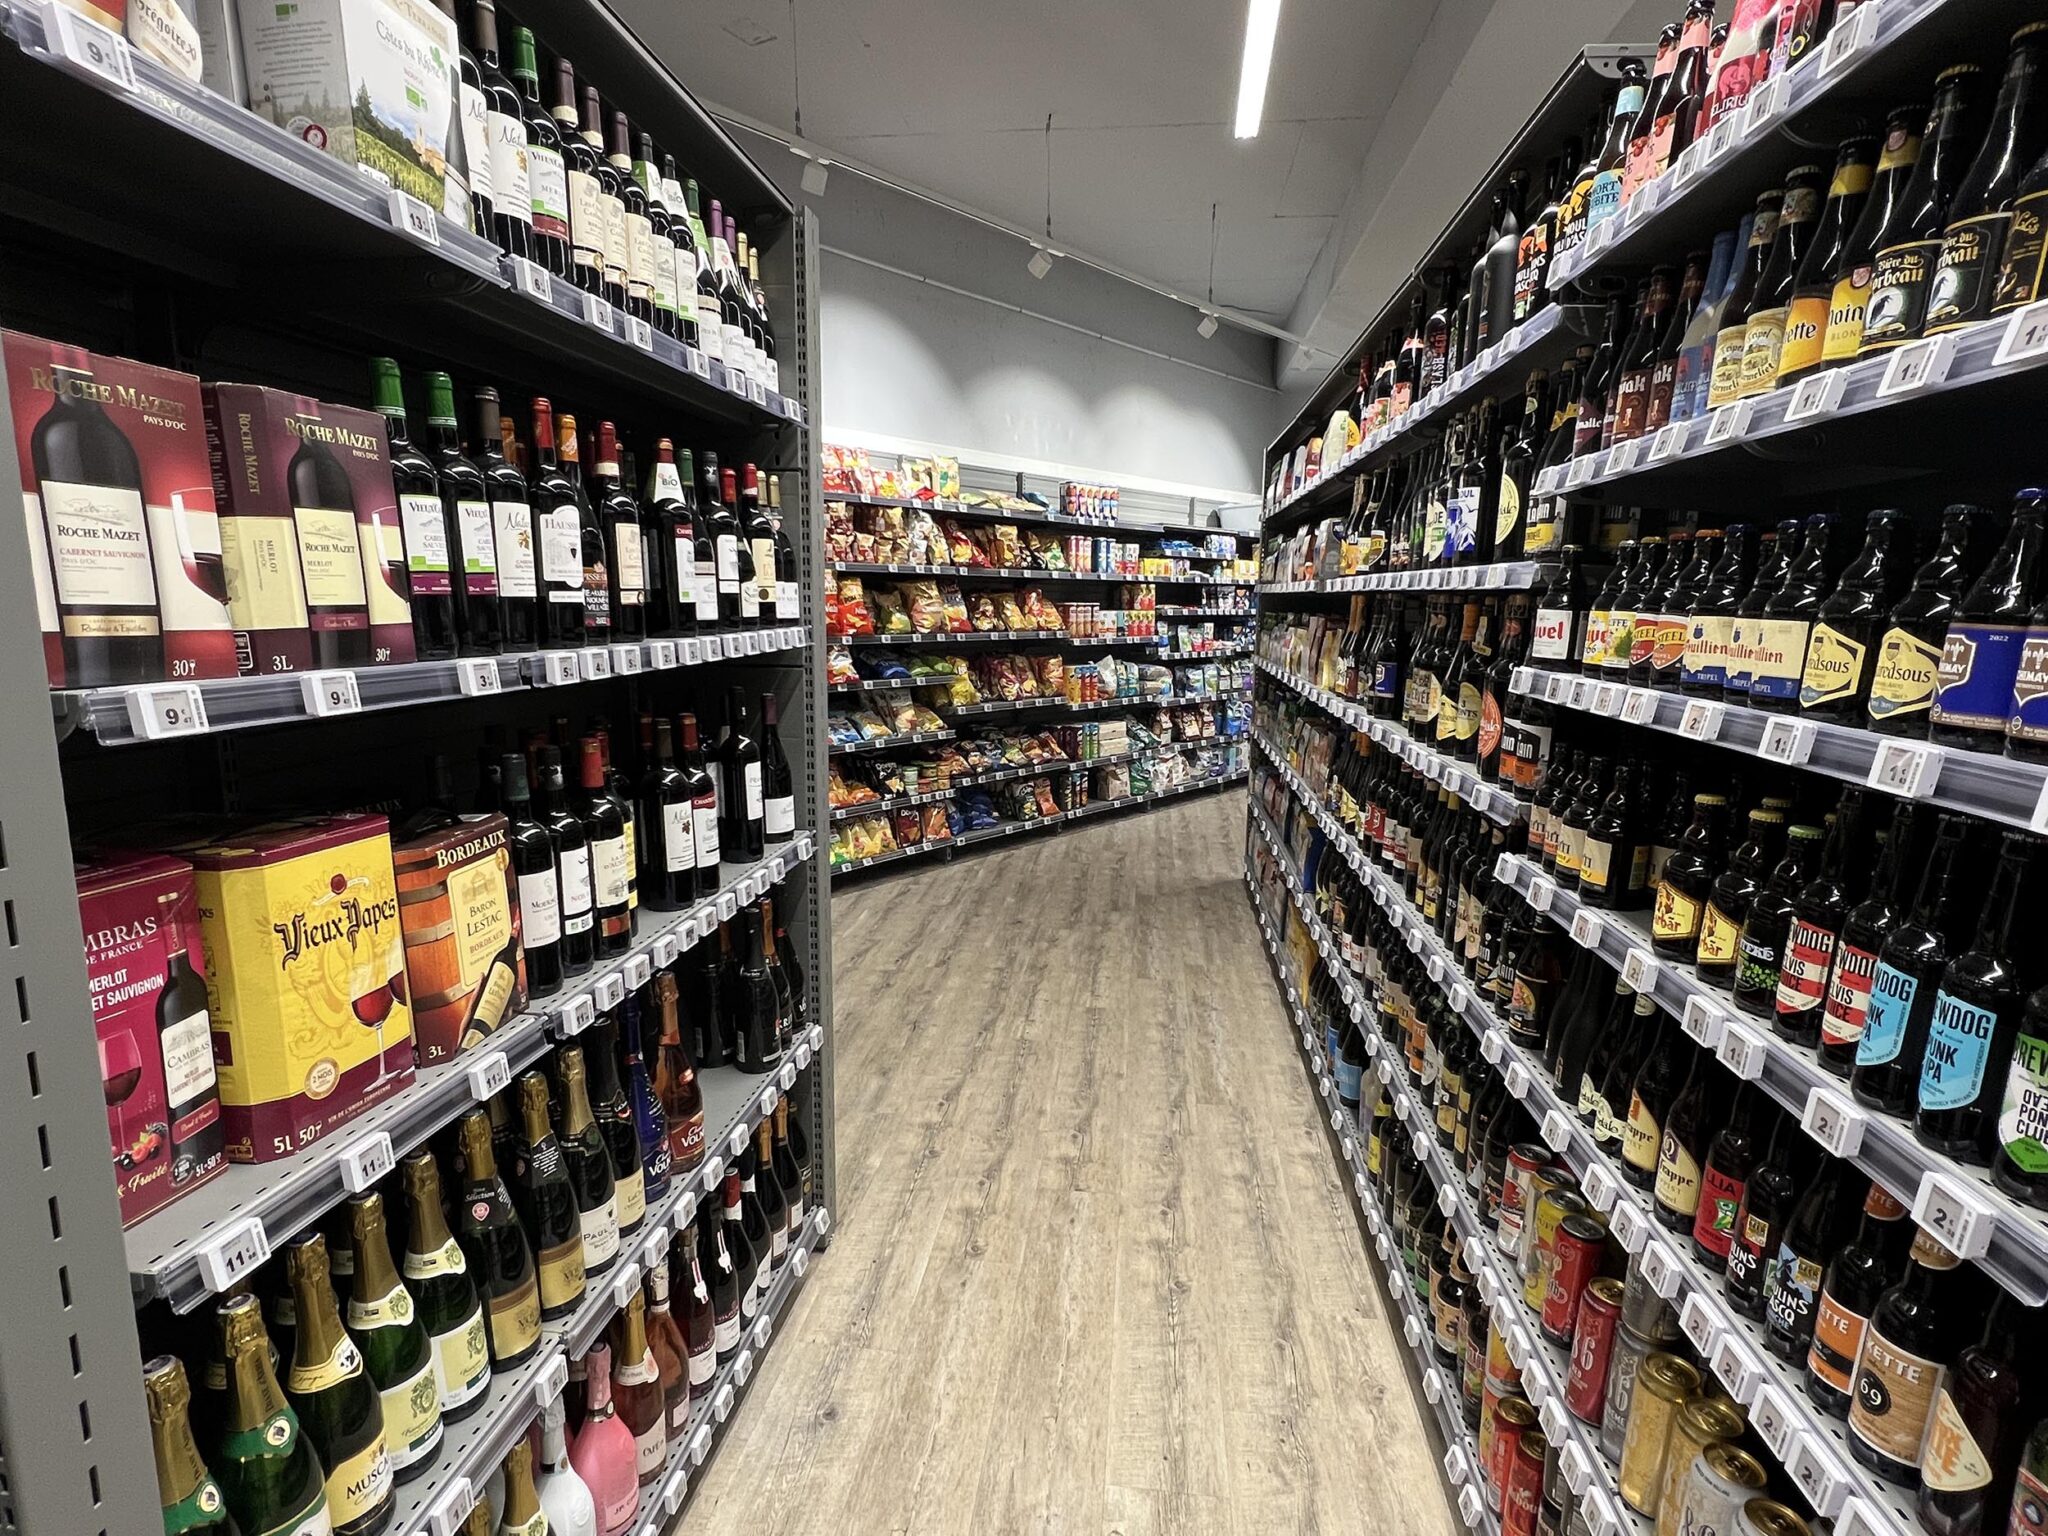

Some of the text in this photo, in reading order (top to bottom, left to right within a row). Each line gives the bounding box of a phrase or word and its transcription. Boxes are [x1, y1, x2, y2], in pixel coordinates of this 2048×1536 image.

[87, 41, 103, 64] 9
[410, 213, 423, 230] 13
[2025, 325, 2038, 346] 1
[1901, 363, 1912, 381] 1
[30, 366, 187, 419] ROCHE MAZET
[143, 414, 187, 431] PAYS D'OC
[285, 417, 379, 452] ROCHE MAZET
[238, 412, 261, 495] ROCHE MAZET
[57, 525, 141, 542] ROCHE MAZET
[60, 548, 146, 559] CABERNET SAUVIGNON
[305, 542, 355, 554] ROCHE MAZET
[1989, 634, 2010, 642] 2022
[272, 655, 293, 671] 3L
[376, 649, 386, 662] 30
[172, 660, 188, 676] 30
[1697, 672, 1719, 681] TRIPEL
[480, 675, 488, 687] 3
[331, 692, 341, 706] 9
[165, 708, 179, 725] 9
[435, 829, 507, 870] BORDEAUX
[469, 897, 497, 918] BARON
[467, 909, 502, 937] LESTAC
[273, 897, 397, 972] Vieux Papes
[469, 929, 505, 954] BORDEAUX
[101, 940, 144, 961] FRANCE
[107, 973, 165, 1005] SAUVIGNON
[167, 1041, 210, 1069] CAMBRAS
[428, 1045, 446, 1058] 3L
[312, 1069, 333, 1084] 2 MOIS
[1817, 1116, 1829, 1135] 2
[273, 1125, 315, 1154] 5L 50
[128, 1161, 169, 1193] Fruité
[361, 1160, 376, 1178] 11
[1933, 1207, 1947, 1229] 2
[225, 1250, 244, 1273] 11
[1691, 1320, 1700, 1335] 2
[1725, 1361, 1734, 1377] 2
[1860, 1377, 1882, 1406] 69
[1763, 1415, 1773, 1433] 2
[1801, 1466, 1813, 1486] 2
